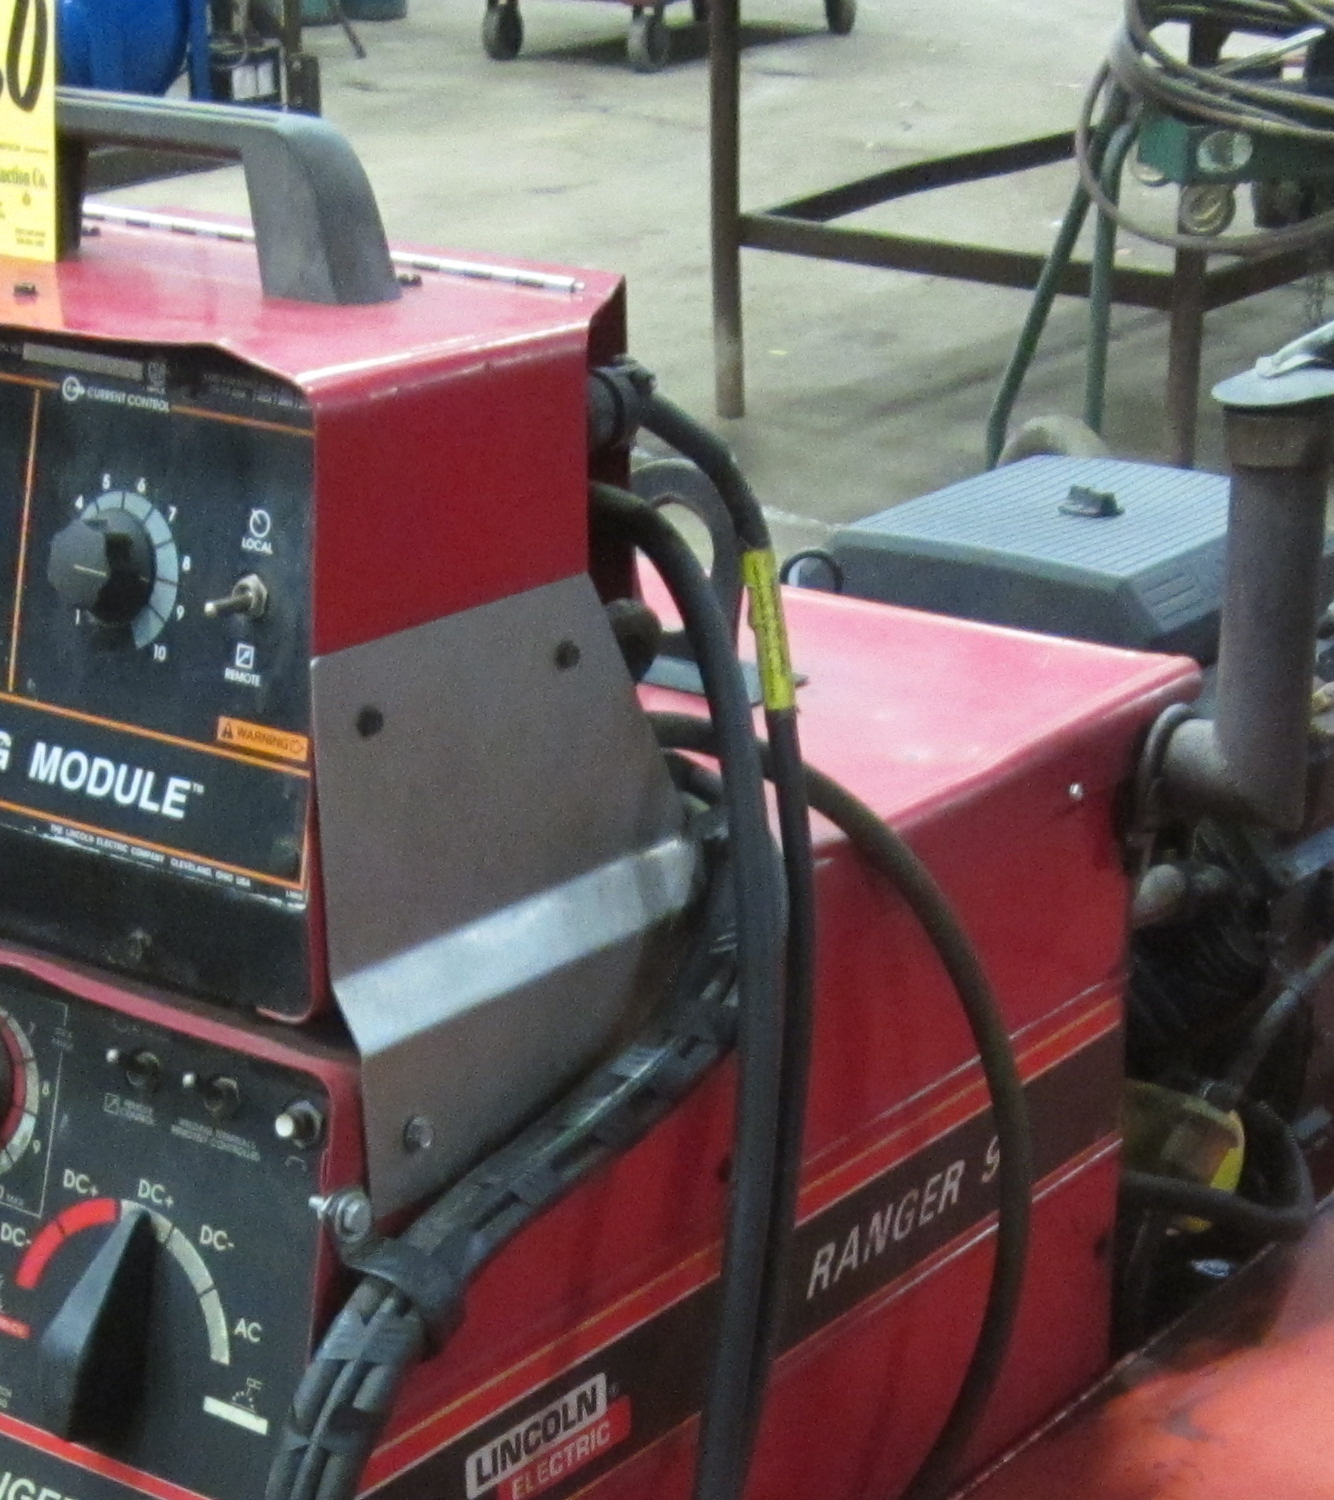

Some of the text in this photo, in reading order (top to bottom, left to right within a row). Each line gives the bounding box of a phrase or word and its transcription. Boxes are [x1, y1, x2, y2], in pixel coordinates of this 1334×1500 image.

[32, 167, 48, 188] Co.
[87, 386, 170, 412] CURRENT CONTROL
[102, 473, 111, 490] 5
[136, 476, 147, 493] 6
[75, 494, 84, 510] 4
[169, 505, 178, 522] 7
[241, 537, 274, 554] LOCAL
[182, 555, 191, 572] 8
[75, 608, 80, 625] 1
[176, 604, 185, 621] 9
[153, 644, 167, 662] 10
[224, 667, 261, 687] REMOTE
[237, 728, 291, 751] WARNING
[28, 741, 192, 819] MODULE
[65, 828, 95, 843] LINCOLN
[96, 838, 129, 854] ELECTRIC
[130, 846, 165, 863] COMPANY
[41, 1080, 50, 1097] 8
[32, 1139, 41, 1154] 9
[63, 1168, 99, 1197] DC+
[137, 1178, 174, 1209] DC+
[0, 1222, 31, 1248] DC-
[200, 1224, 235, 1251] DC-
[806, 1159, 965, 1300] RANGER
[233, 1317, 262, 1343] AC
[475, 1384, 598, 1487] LINCOLN
